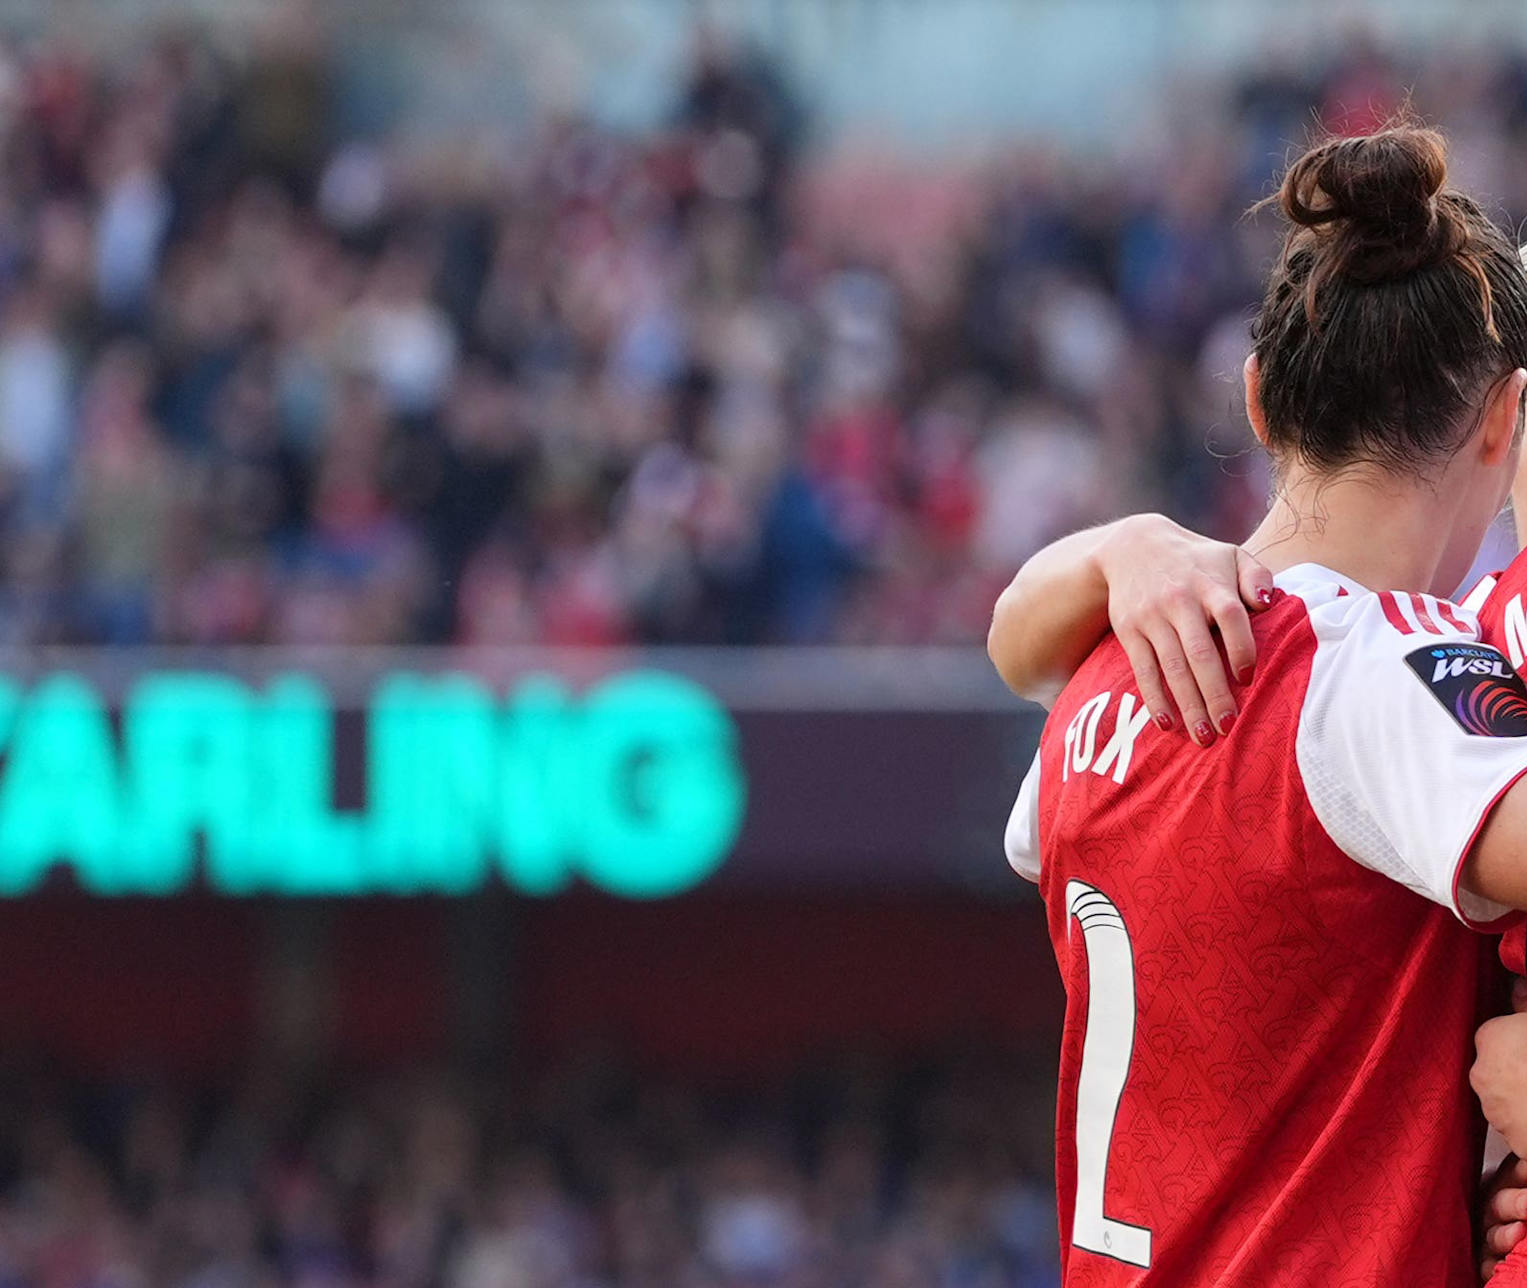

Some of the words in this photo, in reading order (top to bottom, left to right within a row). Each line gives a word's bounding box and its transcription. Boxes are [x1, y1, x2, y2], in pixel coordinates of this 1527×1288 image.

[1431, 656, 1515, 684] WSL
[0, 668, 747, 898] ARLING
[1062, 690, 1152, 785] FOX
